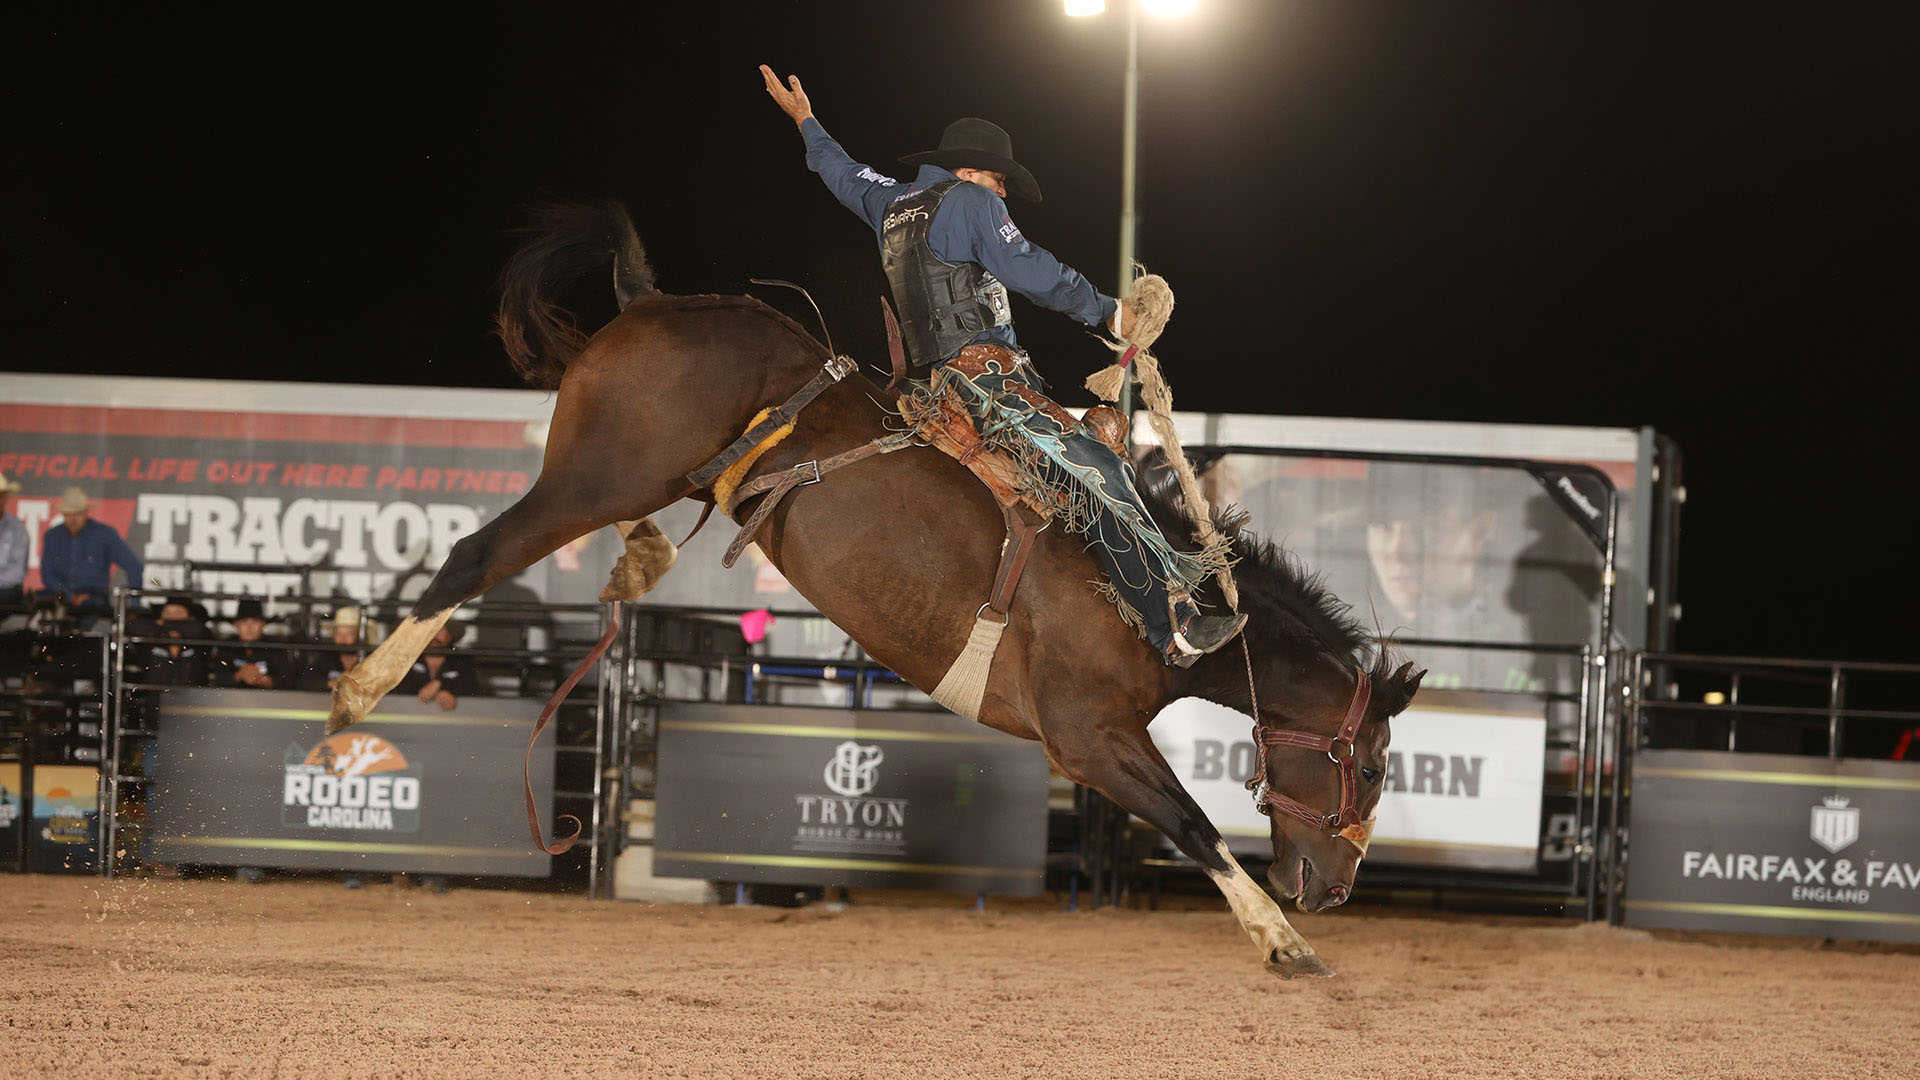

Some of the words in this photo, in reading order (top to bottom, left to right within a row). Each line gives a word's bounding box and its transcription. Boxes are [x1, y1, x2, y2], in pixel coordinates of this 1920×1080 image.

[127, 458, 199, 483] LIFE
[206, 460, 276, 485] OUT
[280, 462, 370, 489] HERE
[375, 465, 529, 495] PARTNER
[137, 493, 480, 572] TRACTOR
[1192, 739, 1256, 783] BO
[1384, 752, 1484, 798] ARN
[284, 773, 420, 810] RODEO
[306, 805, 394, 830] CAROLINA
[796, 796, 905, 828] TRYON
[1682, 850, 1826, 885] FAIRFAX
[1830, 858, 1858, 887] &
[1792, 885, 1870, 904] ENGLAND
